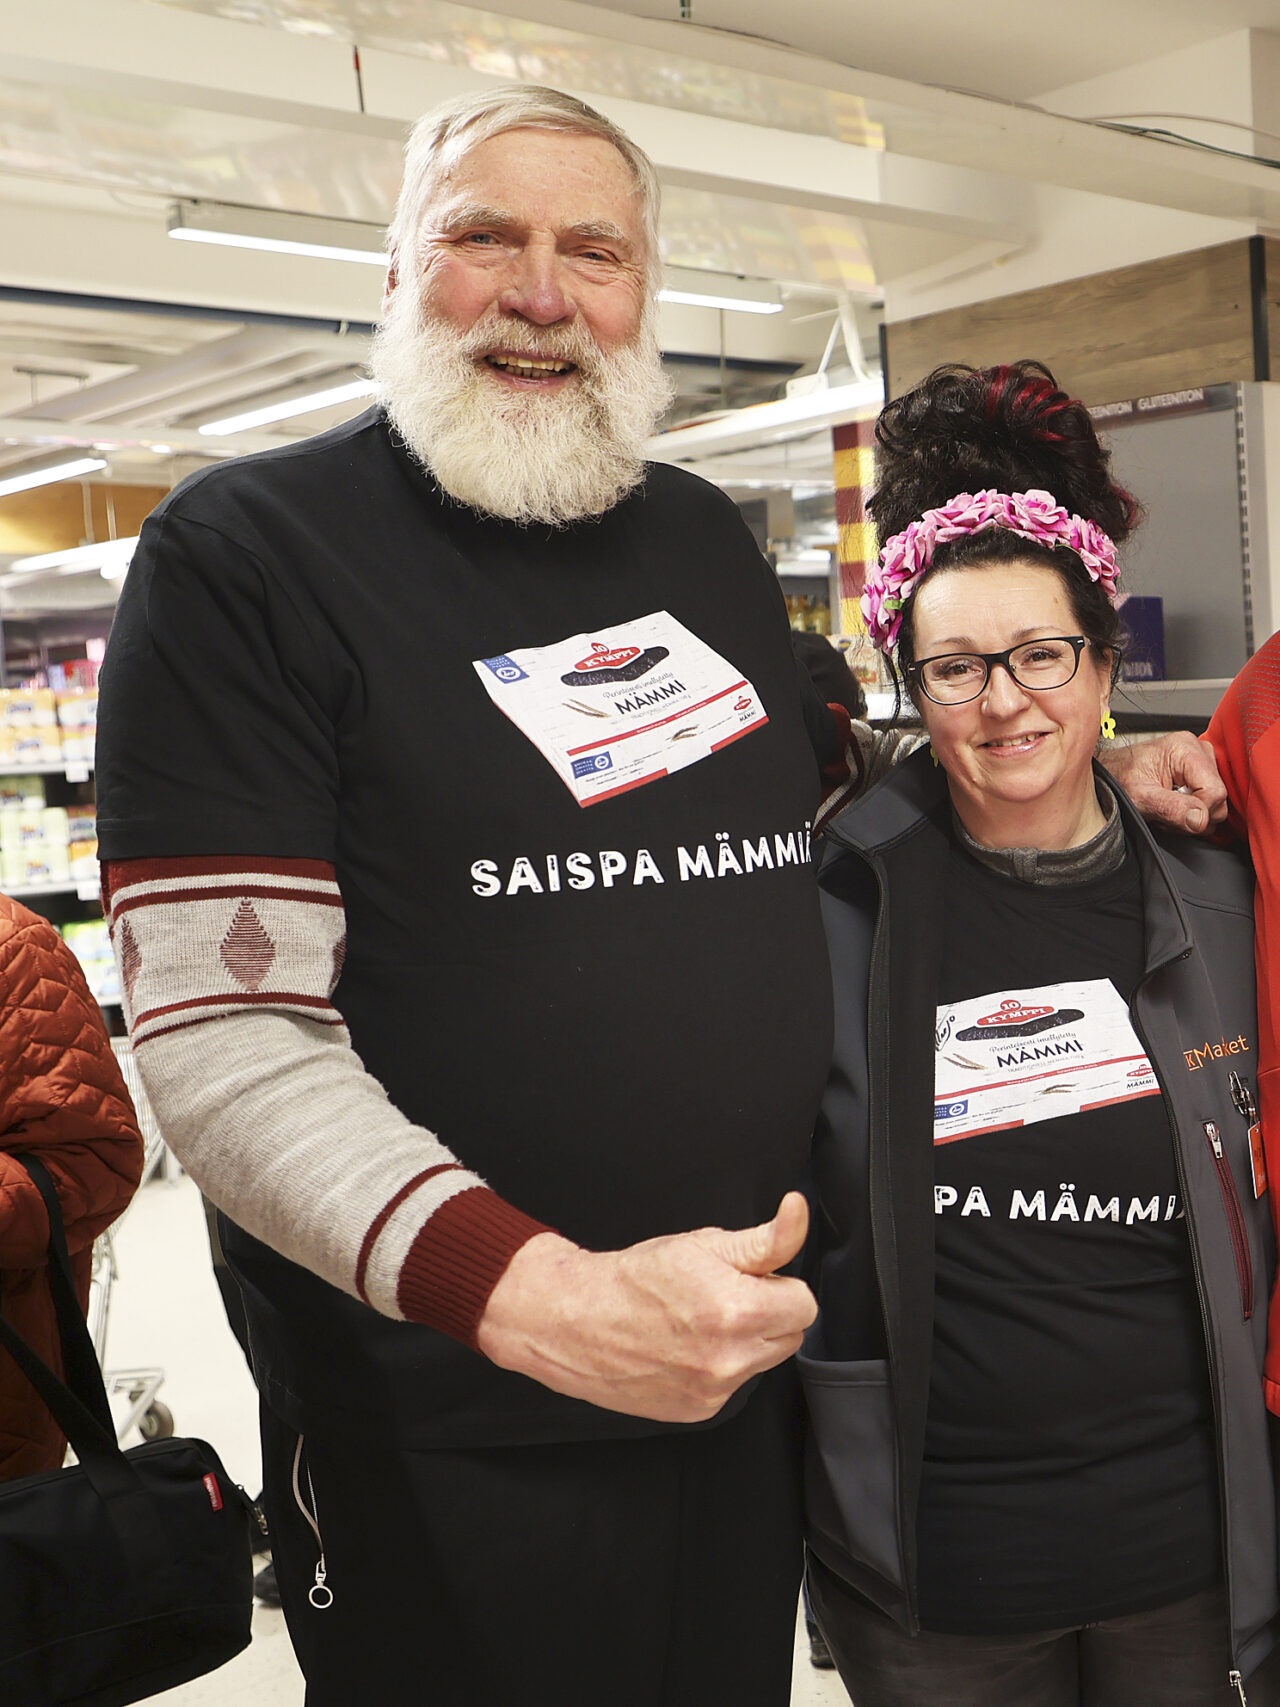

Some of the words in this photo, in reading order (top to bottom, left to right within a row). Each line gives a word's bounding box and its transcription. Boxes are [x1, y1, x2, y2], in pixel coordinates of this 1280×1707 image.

[584, 649, 633, 668] KYMPPI
[593, 644, 605, 653] 10
[614, 680, 687, 715] MÄMMI
[470, 849, 665, 898] SAISPA
[987, 1008, 1046, 1024] KYMPPI
[1002, 1001, 1019, 1010] 10
[997, 1040, 1083, 1067] MÄMMI
[934, 1185, 991, 1217] PA
[1009, 1183, 1185, 1225] MÄMMI
